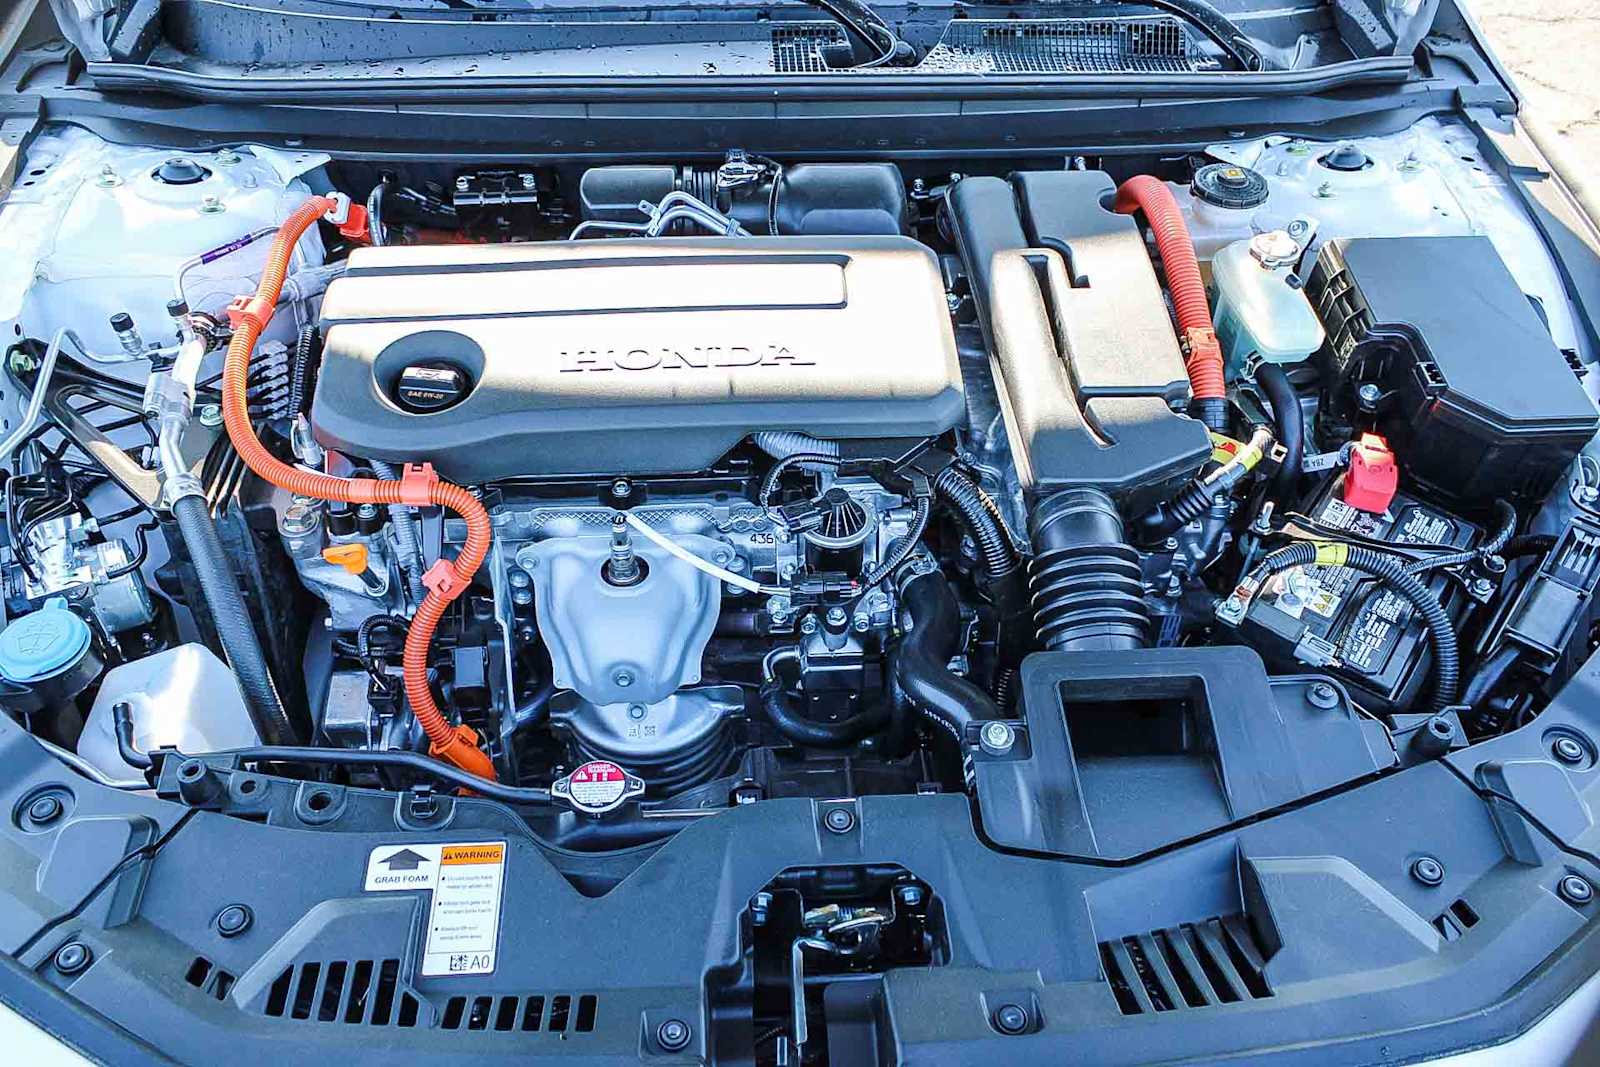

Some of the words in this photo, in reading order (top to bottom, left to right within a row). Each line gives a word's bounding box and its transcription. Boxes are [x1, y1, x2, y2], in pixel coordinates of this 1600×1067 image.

[560, 346, 816, 372] HONDA
[750, 533, 774, 544] 436
[454, 851, 500, 859] WARNING
[374, 875, 401, 884] GRAB
[403, 874, 429, 883] FOAM
